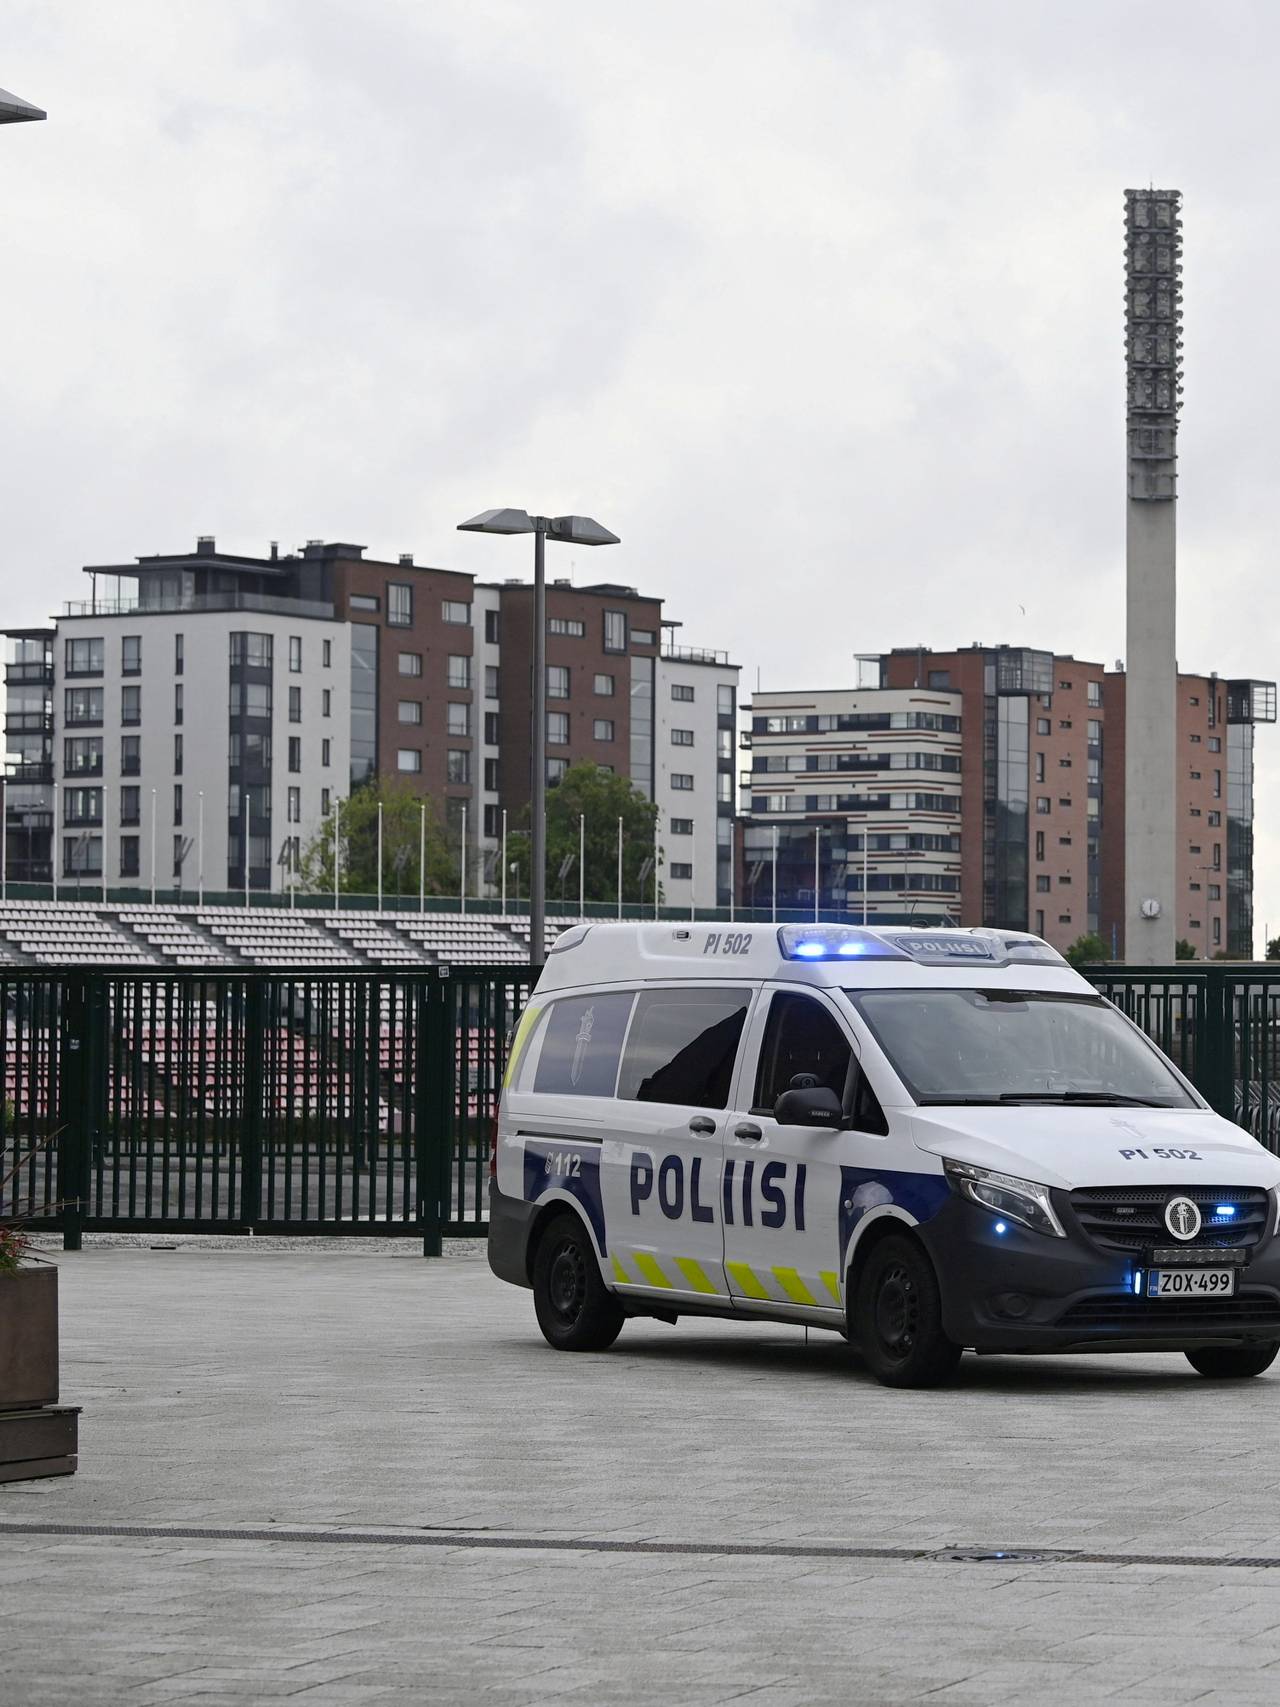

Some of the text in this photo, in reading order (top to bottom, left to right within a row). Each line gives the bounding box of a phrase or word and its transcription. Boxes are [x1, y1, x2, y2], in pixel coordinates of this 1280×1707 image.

[703, 933, 753, 955] PI 502
[909, 941, 982, 953] POLIISI
[555, 1152, 581, 1178] 112
[1118, 1148, 1203, 1160] PI 502
[630, 1151, 807, 1231] POLIISI
